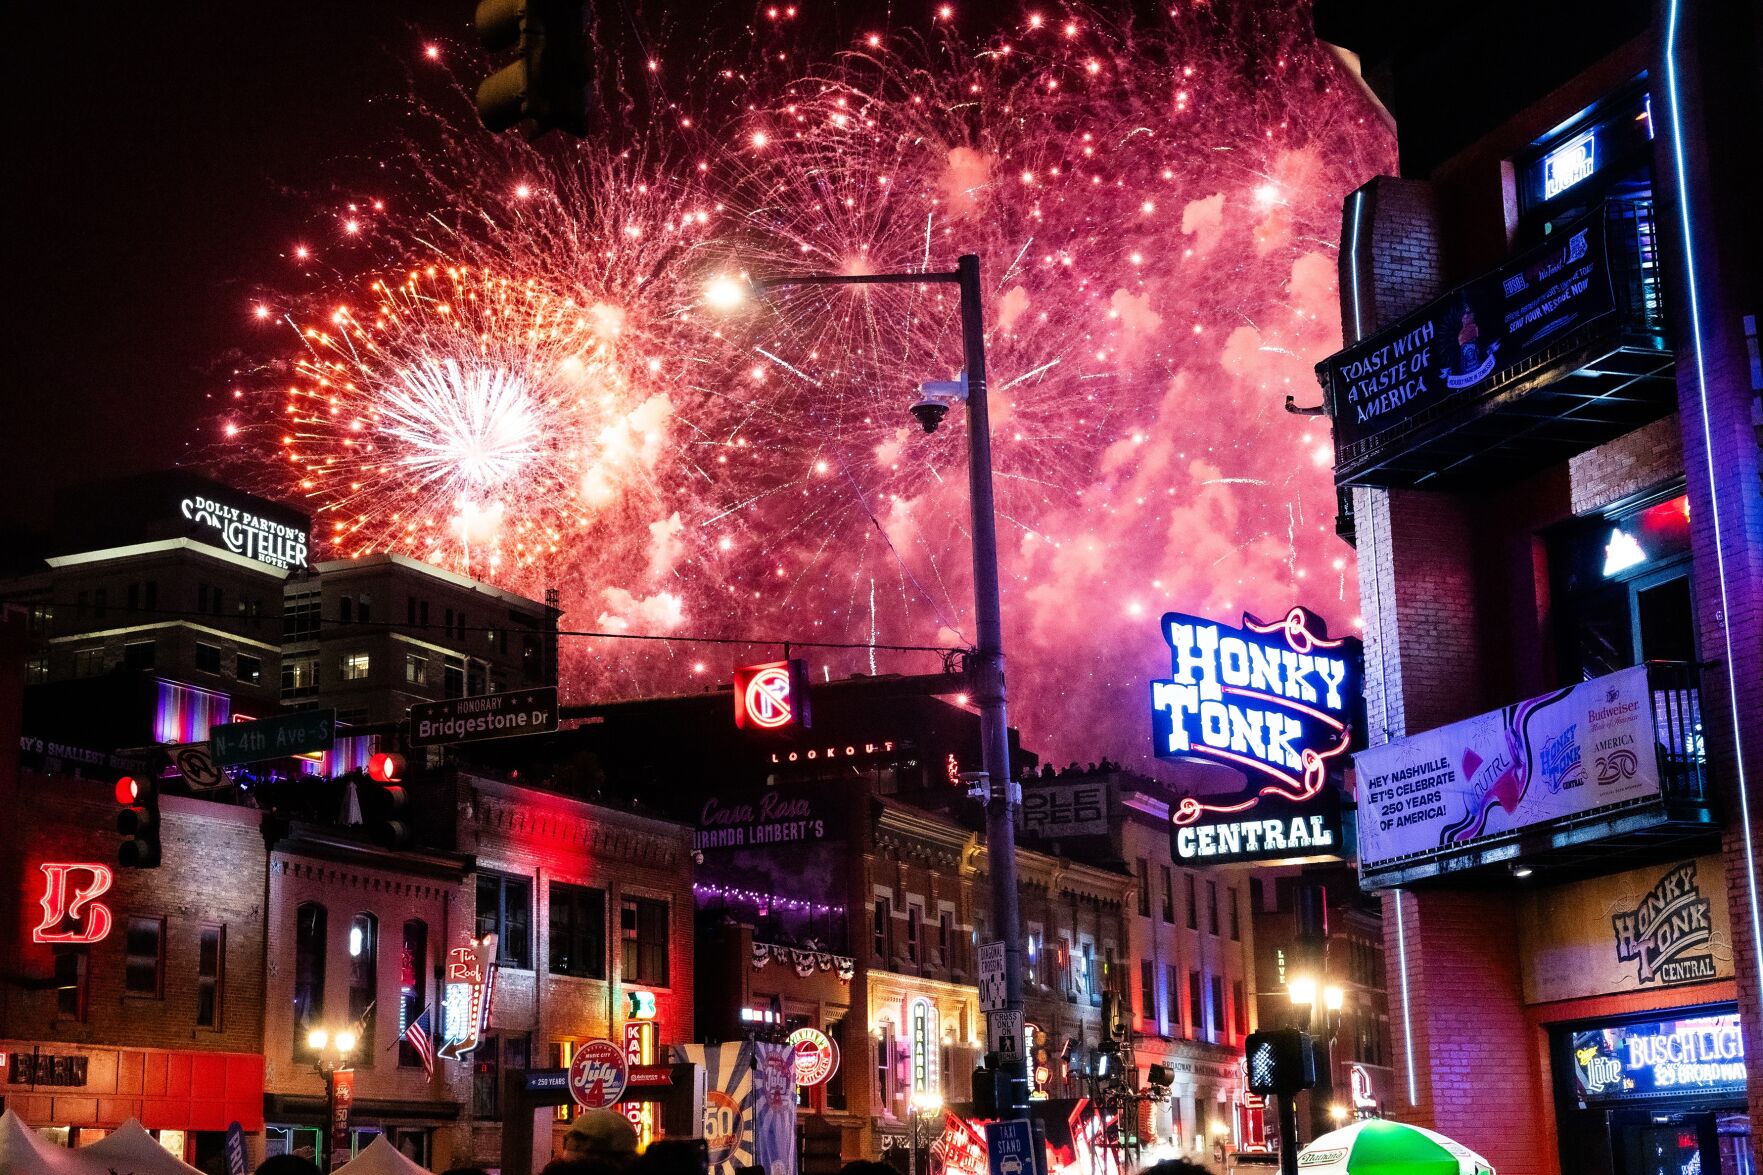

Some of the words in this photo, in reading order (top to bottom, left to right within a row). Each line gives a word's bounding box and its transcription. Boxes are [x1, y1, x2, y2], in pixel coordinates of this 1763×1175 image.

[1340, 345, 1390, 382] TOAST
[1393, 319, 1434, 359] WITH
[1349, 383, 1359, 403] A
[1358, 360, 1407, 399] TASTE
[1411, 346, 1431, 373] OF
[1357, 376, 1428, 424] AMERICA
[181, 499, 308, 569] SONGTELLER
[196, 496, 240, 521] DOLLY
[242, 512, 306, 544] PARTON'S
[258, 553, 288, 570] HOTEL
[1170, 622, 1345, 710] HONKY
[458, 697, 503, 715] HONORARY
[1587, 700, 1640, 724] Budweiser
[419, 712, 528, 739] Bridgestone
[532, 711, 549, 726] Dr
[1153, 682, 1303, 772] TONK
[47, 742, 106, 766] SMALLEST
[771, 741, 894, 764] LOOKOUT
[1594, 734, 1635, 753] AMERICA
[1369, 774, 1390, 791] HEY
[1391, 757, 1451, 784] NASHVILLE,
[1595, 749, 1638, 786] 250
[1396, 770, 1456, 799] CELEBRATE
[702, 797, 755, 826] Casa
[760, 790, 812, 823] Rosa
[1023, 788, 1101, 811] OLE
[1381, 799, 1404, 816] 250
[1406, 791, 1442, 809] YEARS
[749, 818, 825, 844] LAMBERT'S
[1023, 806, 1102, 828] RED
[1380, 816, 1394, 832] OF
[1396, 804, 1447, 829] AMERICA!
[1177, 815, 1334, 859] CENTRAL
[1614, 865, 1696, 959] HONKY
[450, 947, 477, 963] Tin
[1633, 902, 1709, 983] TONK
[449, 963, 483, 982] Roof
[1661, 956, 1716, 982] CENTRAL
[980, 978, 991, 1004] OK
[994, 1012, 1018, 1021] CROSS
[996, 1020, 1016, 1029] ONLY
[1001, 1028, 1012, 1036] ON
[914, 1004, 925, 1092] MIRANDA
[1628, 1033, 1698, 1069] BUSCH
[537, 1077, 549, 1087] 250
[549, 1076, 566, 1086] YEARS
[574, 1059, 618, 1089] July
[1588, 1056, 1622, 1092] Lite
[704, 1106, 734, 1141] 50
[1000, 1125, 1017, 1140] TAXI
[998, 1140, 1021, 1154] STAND
